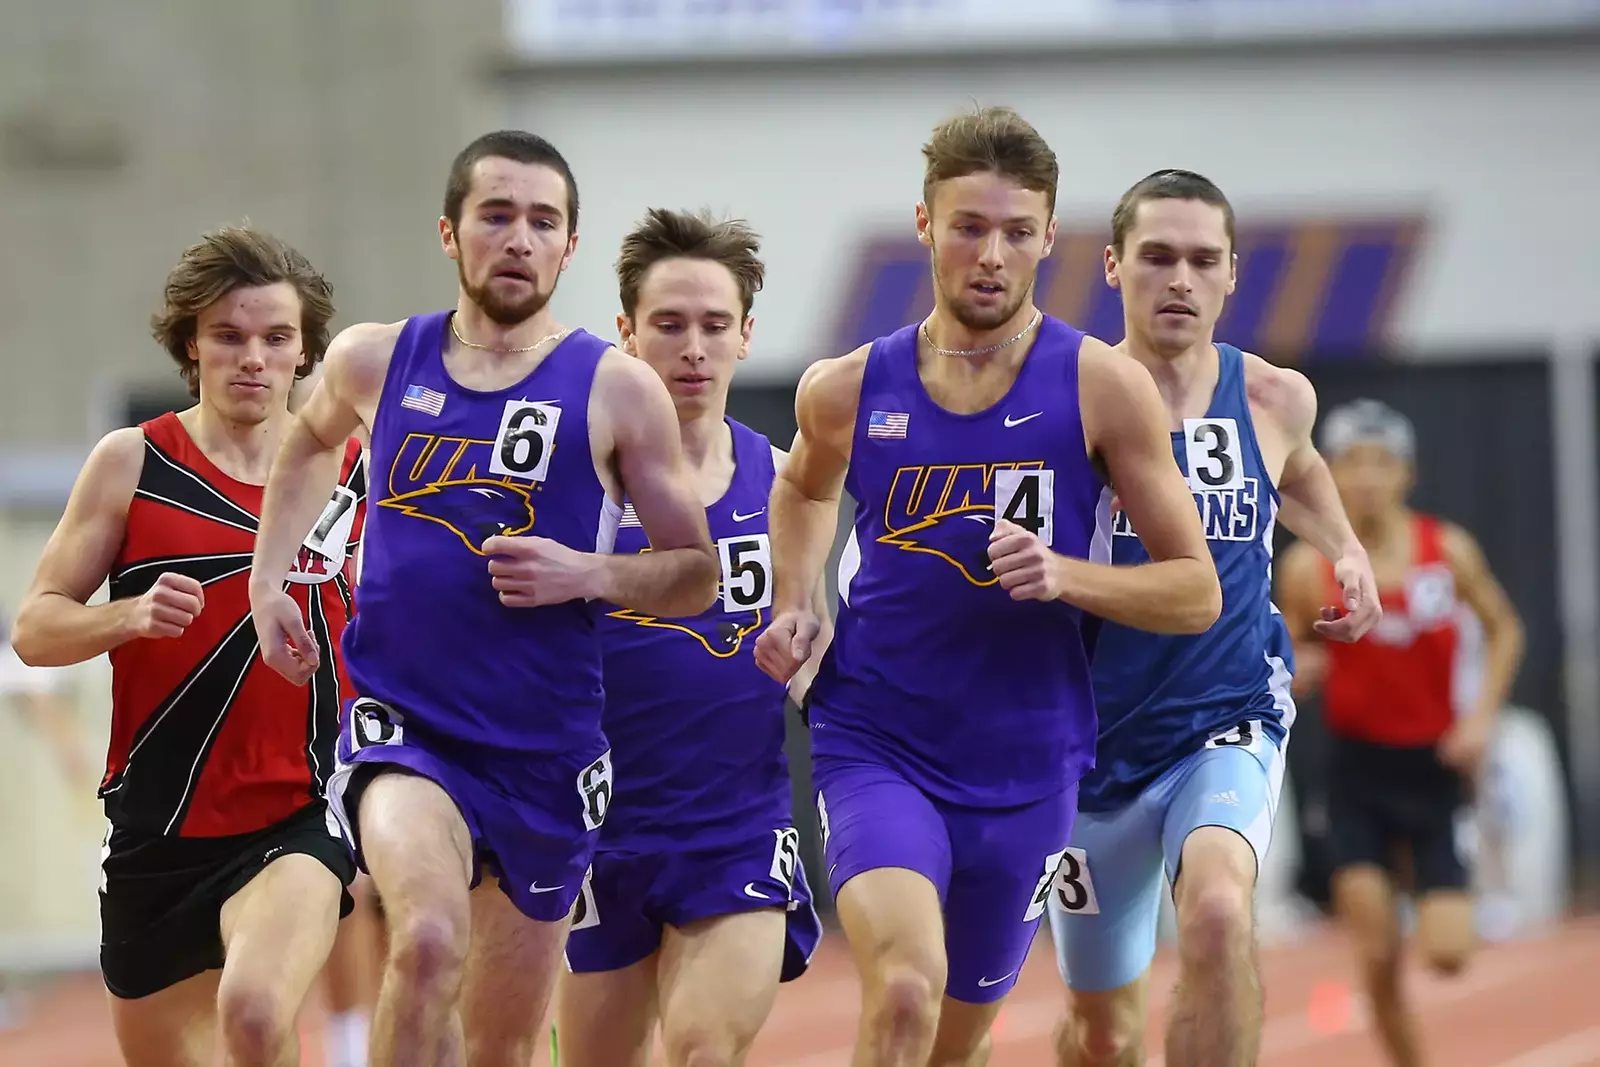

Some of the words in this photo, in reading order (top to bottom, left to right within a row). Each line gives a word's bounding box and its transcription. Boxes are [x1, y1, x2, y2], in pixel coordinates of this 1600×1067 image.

[501, 407, 547, 473] 6
[1194, 424, 1234, 486] 3
[1002, 475, 1045, 537] 4
[728, 540, 766, 606] 5
[582, 760, 610, 826] 6
[1057, 851, 1088, 911] 3
